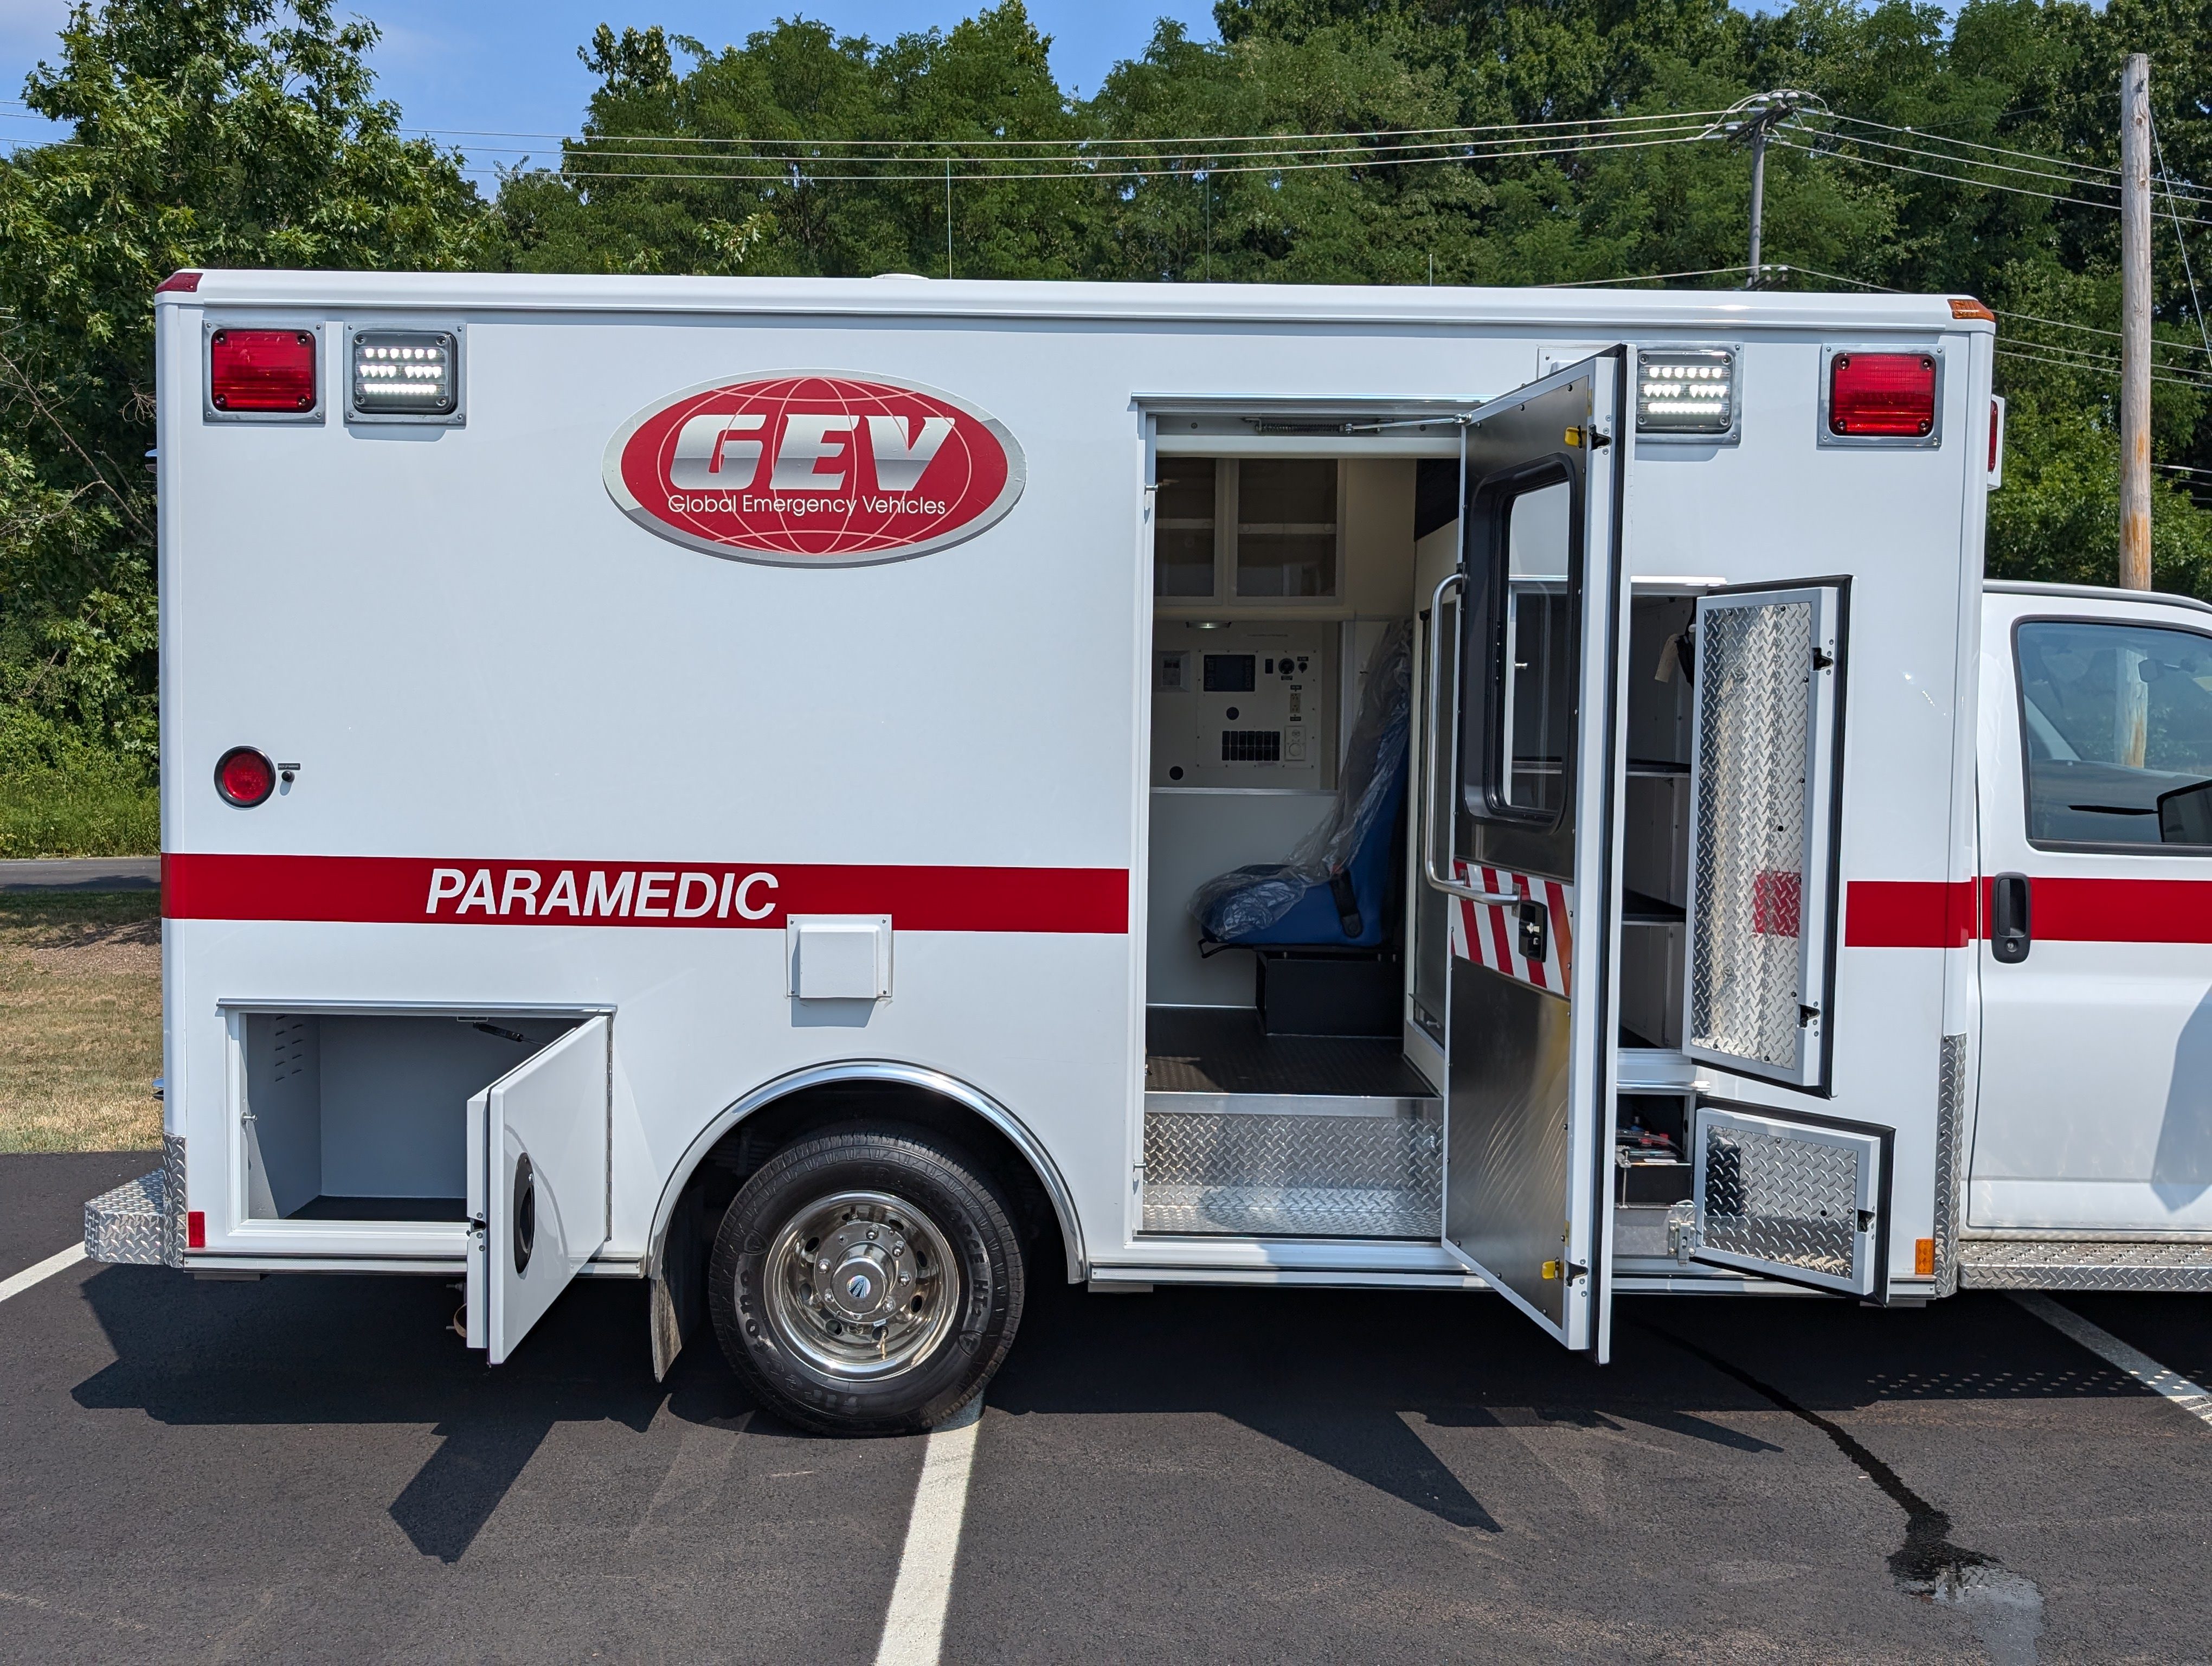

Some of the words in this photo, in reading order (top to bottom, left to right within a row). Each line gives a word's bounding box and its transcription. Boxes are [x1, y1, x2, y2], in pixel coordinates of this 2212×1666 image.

[669, 414, 956, 491] GEV
[667, 495, 737, 513] Global
[743, 496, 857, 518] Emergency
[863, 496, 946, 515] Vehicles
[426, 868, 779, 920] PARAMEDIC
